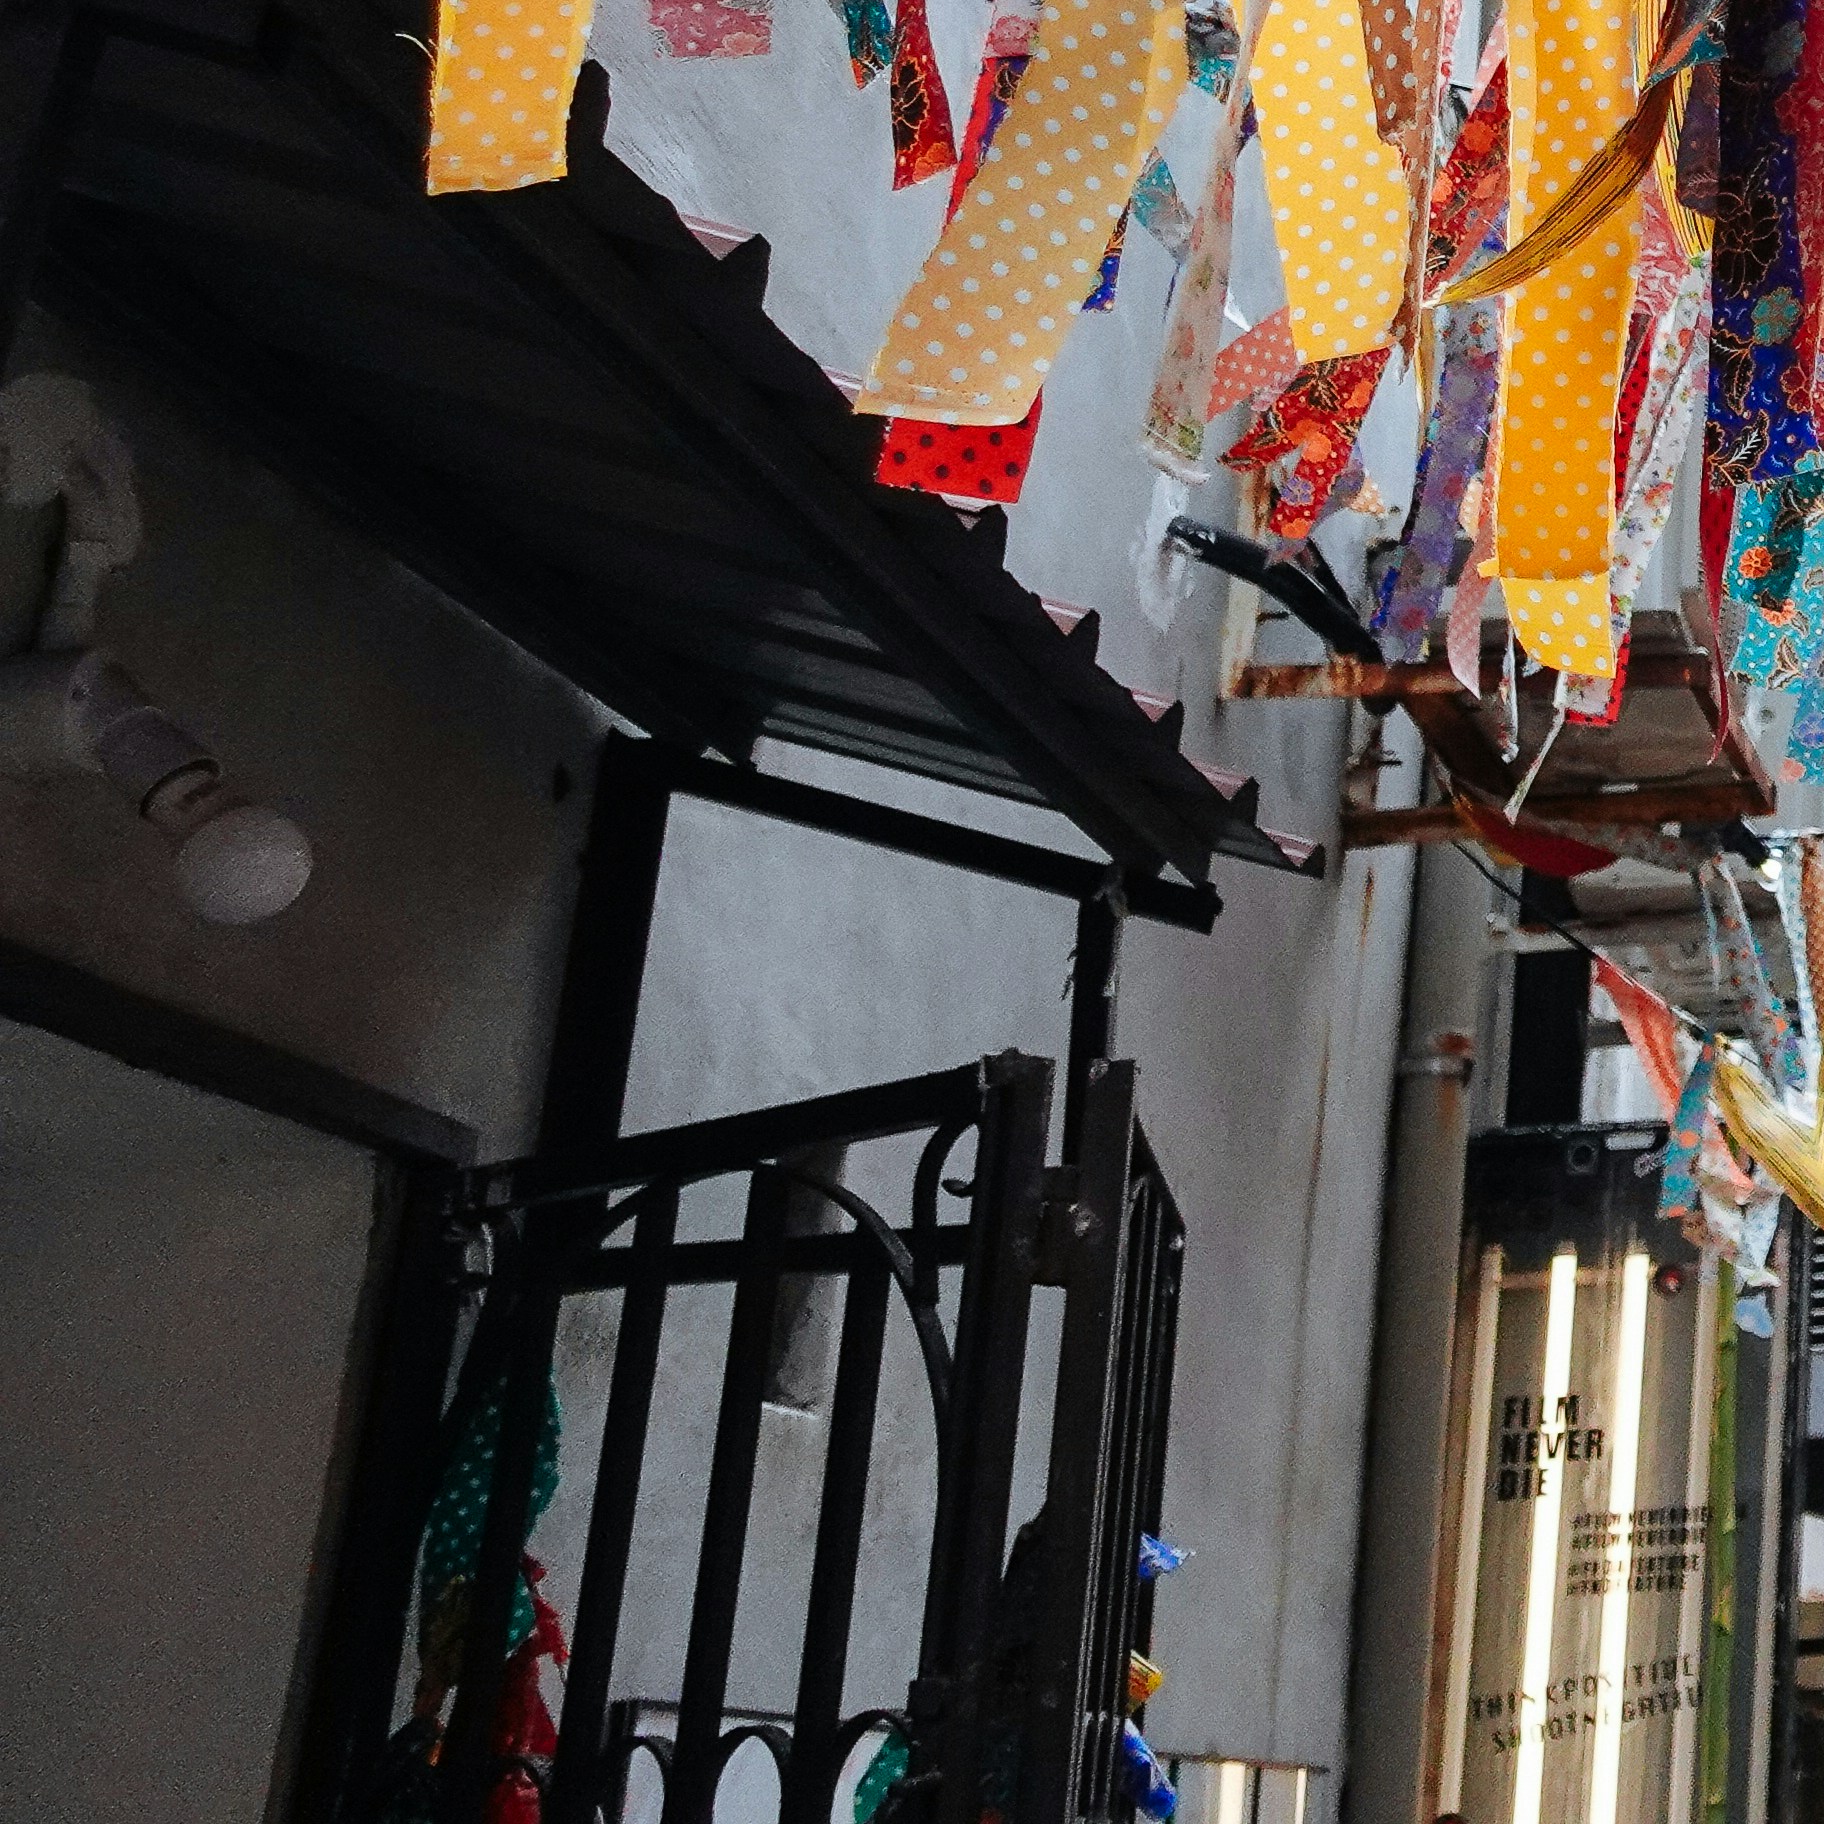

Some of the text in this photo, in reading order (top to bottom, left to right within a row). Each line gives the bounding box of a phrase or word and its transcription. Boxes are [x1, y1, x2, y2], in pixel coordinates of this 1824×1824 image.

[1504, 1395, 1580, 1428] FILM
[1501, 1429, 1603, 1464] NEVER
[1498, 1468, 1548, 1501] DIE
